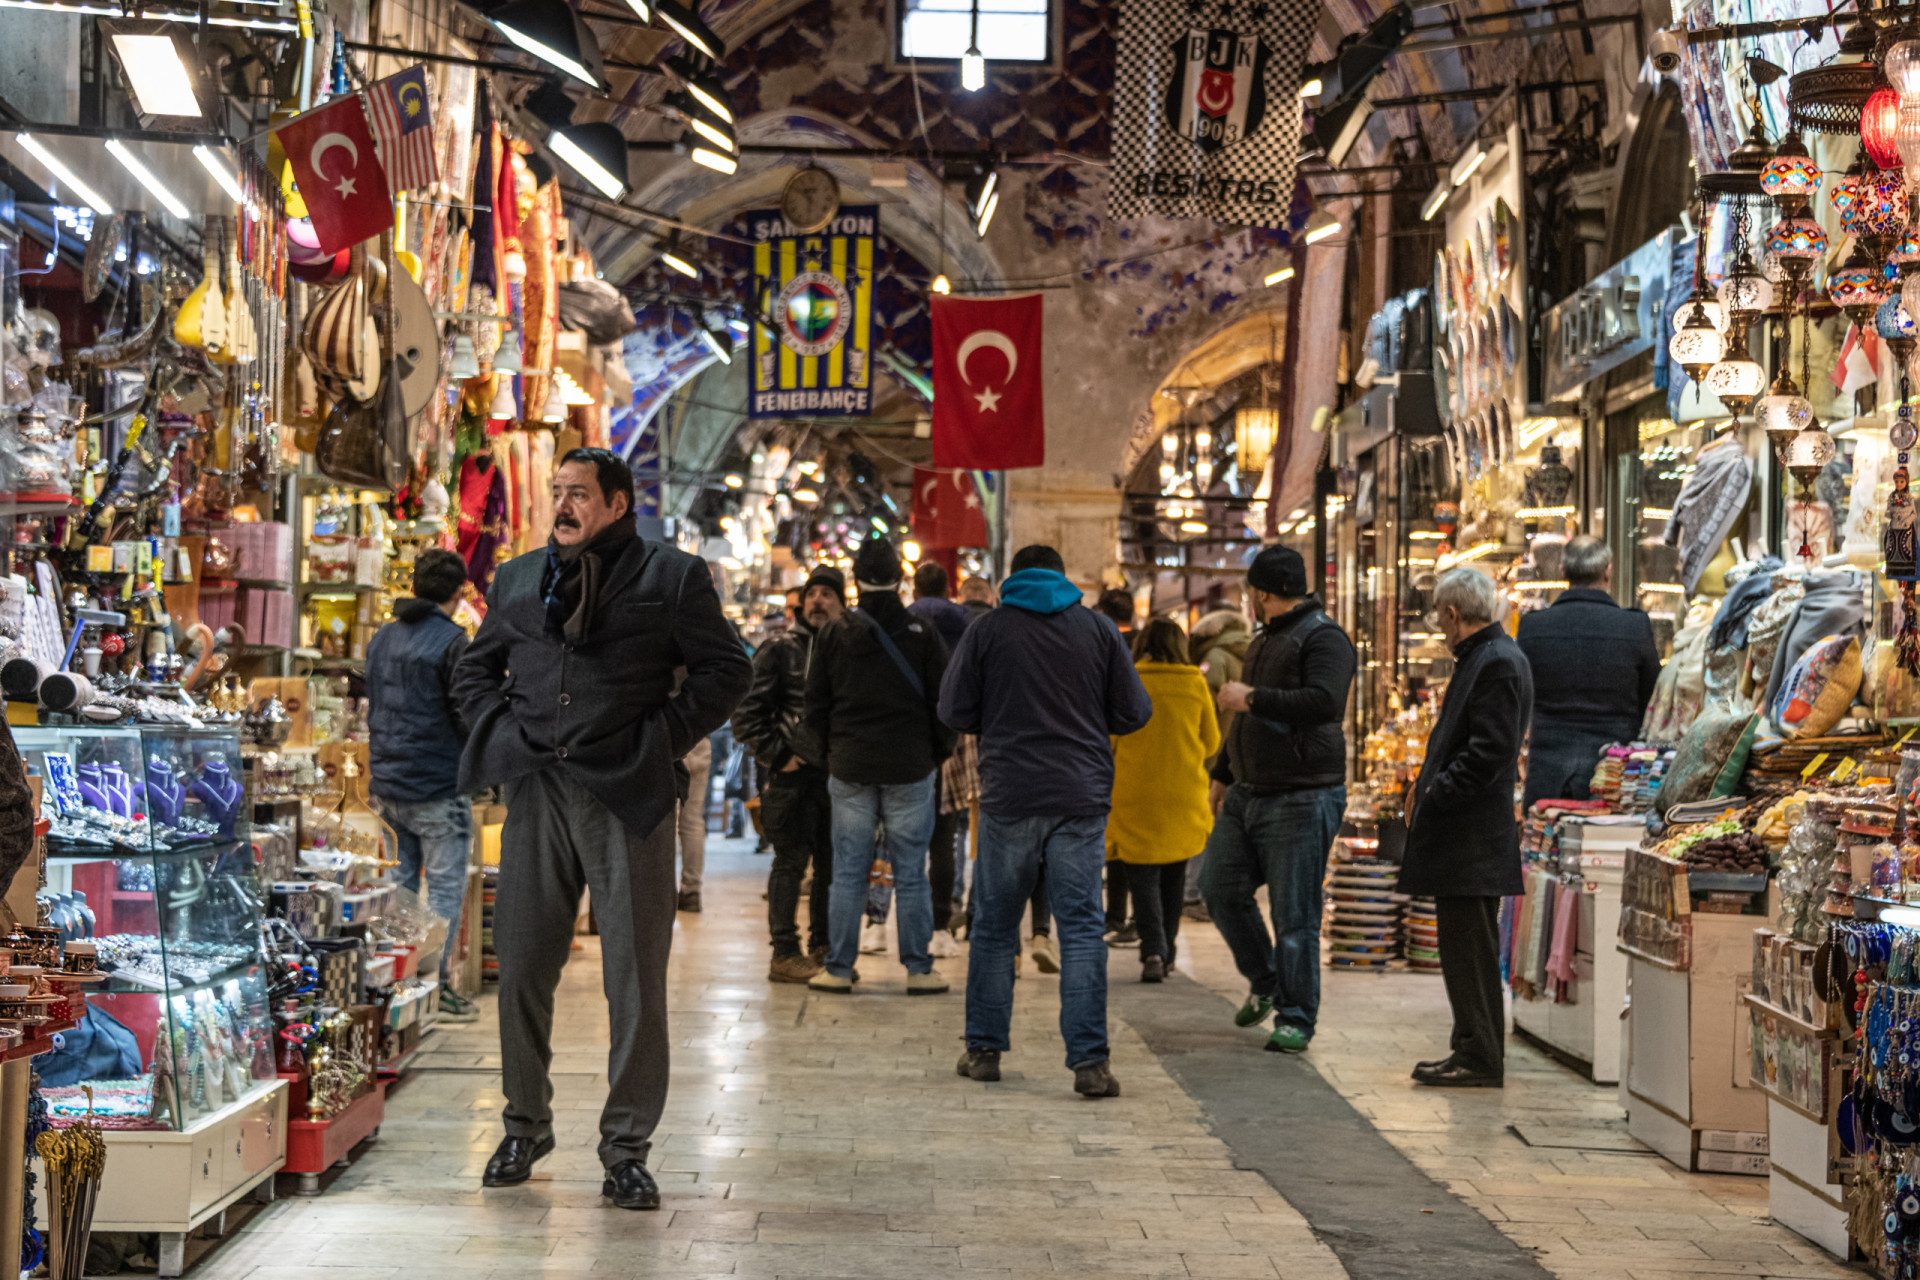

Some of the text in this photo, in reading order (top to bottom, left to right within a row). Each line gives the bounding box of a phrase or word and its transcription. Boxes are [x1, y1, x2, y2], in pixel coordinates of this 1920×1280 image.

[1190, 36, 1253, 68] BJK
[1188, 116, 1238, 142] 1903
[755, 389, 868, 413] FENERBAHÇE
